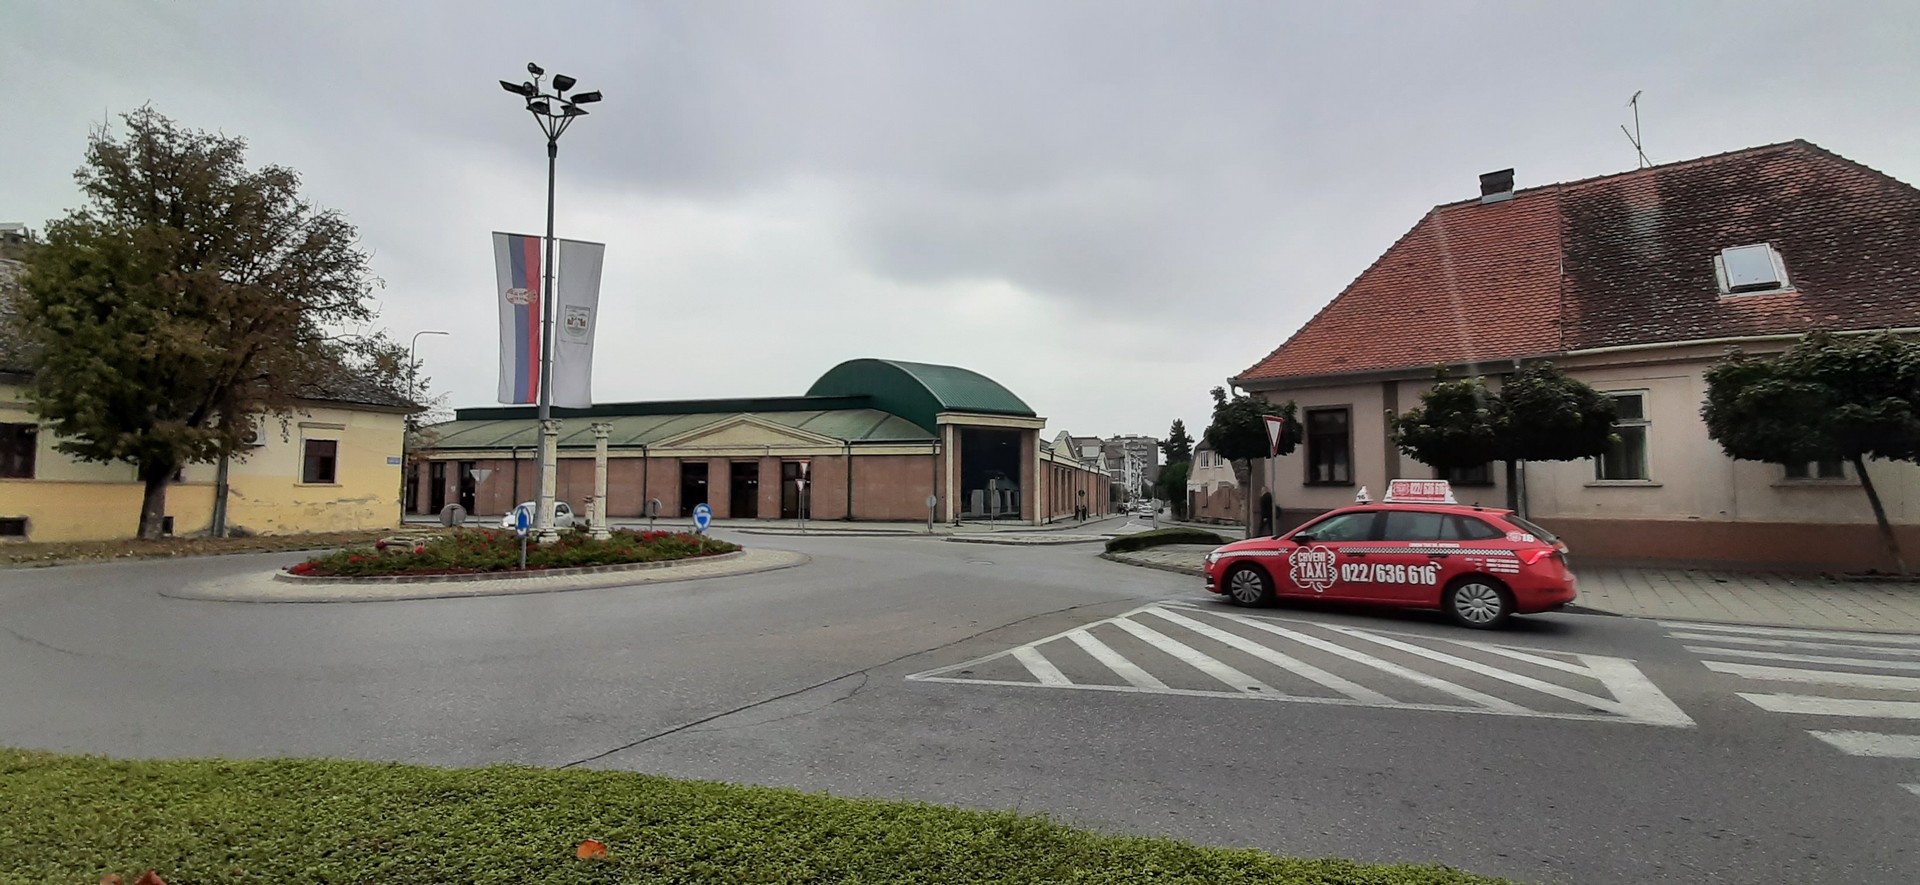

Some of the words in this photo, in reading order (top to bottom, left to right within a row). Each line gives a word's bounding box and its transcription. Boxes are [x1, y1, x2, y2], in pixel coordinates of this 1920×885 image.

[1297, 552, 1326, 562] CRVENI
[1298, 562, 1328, 578] TAXI
[1341, 563, 1406, 584] 022/636
[1408, 564, 1437, 585] 616
